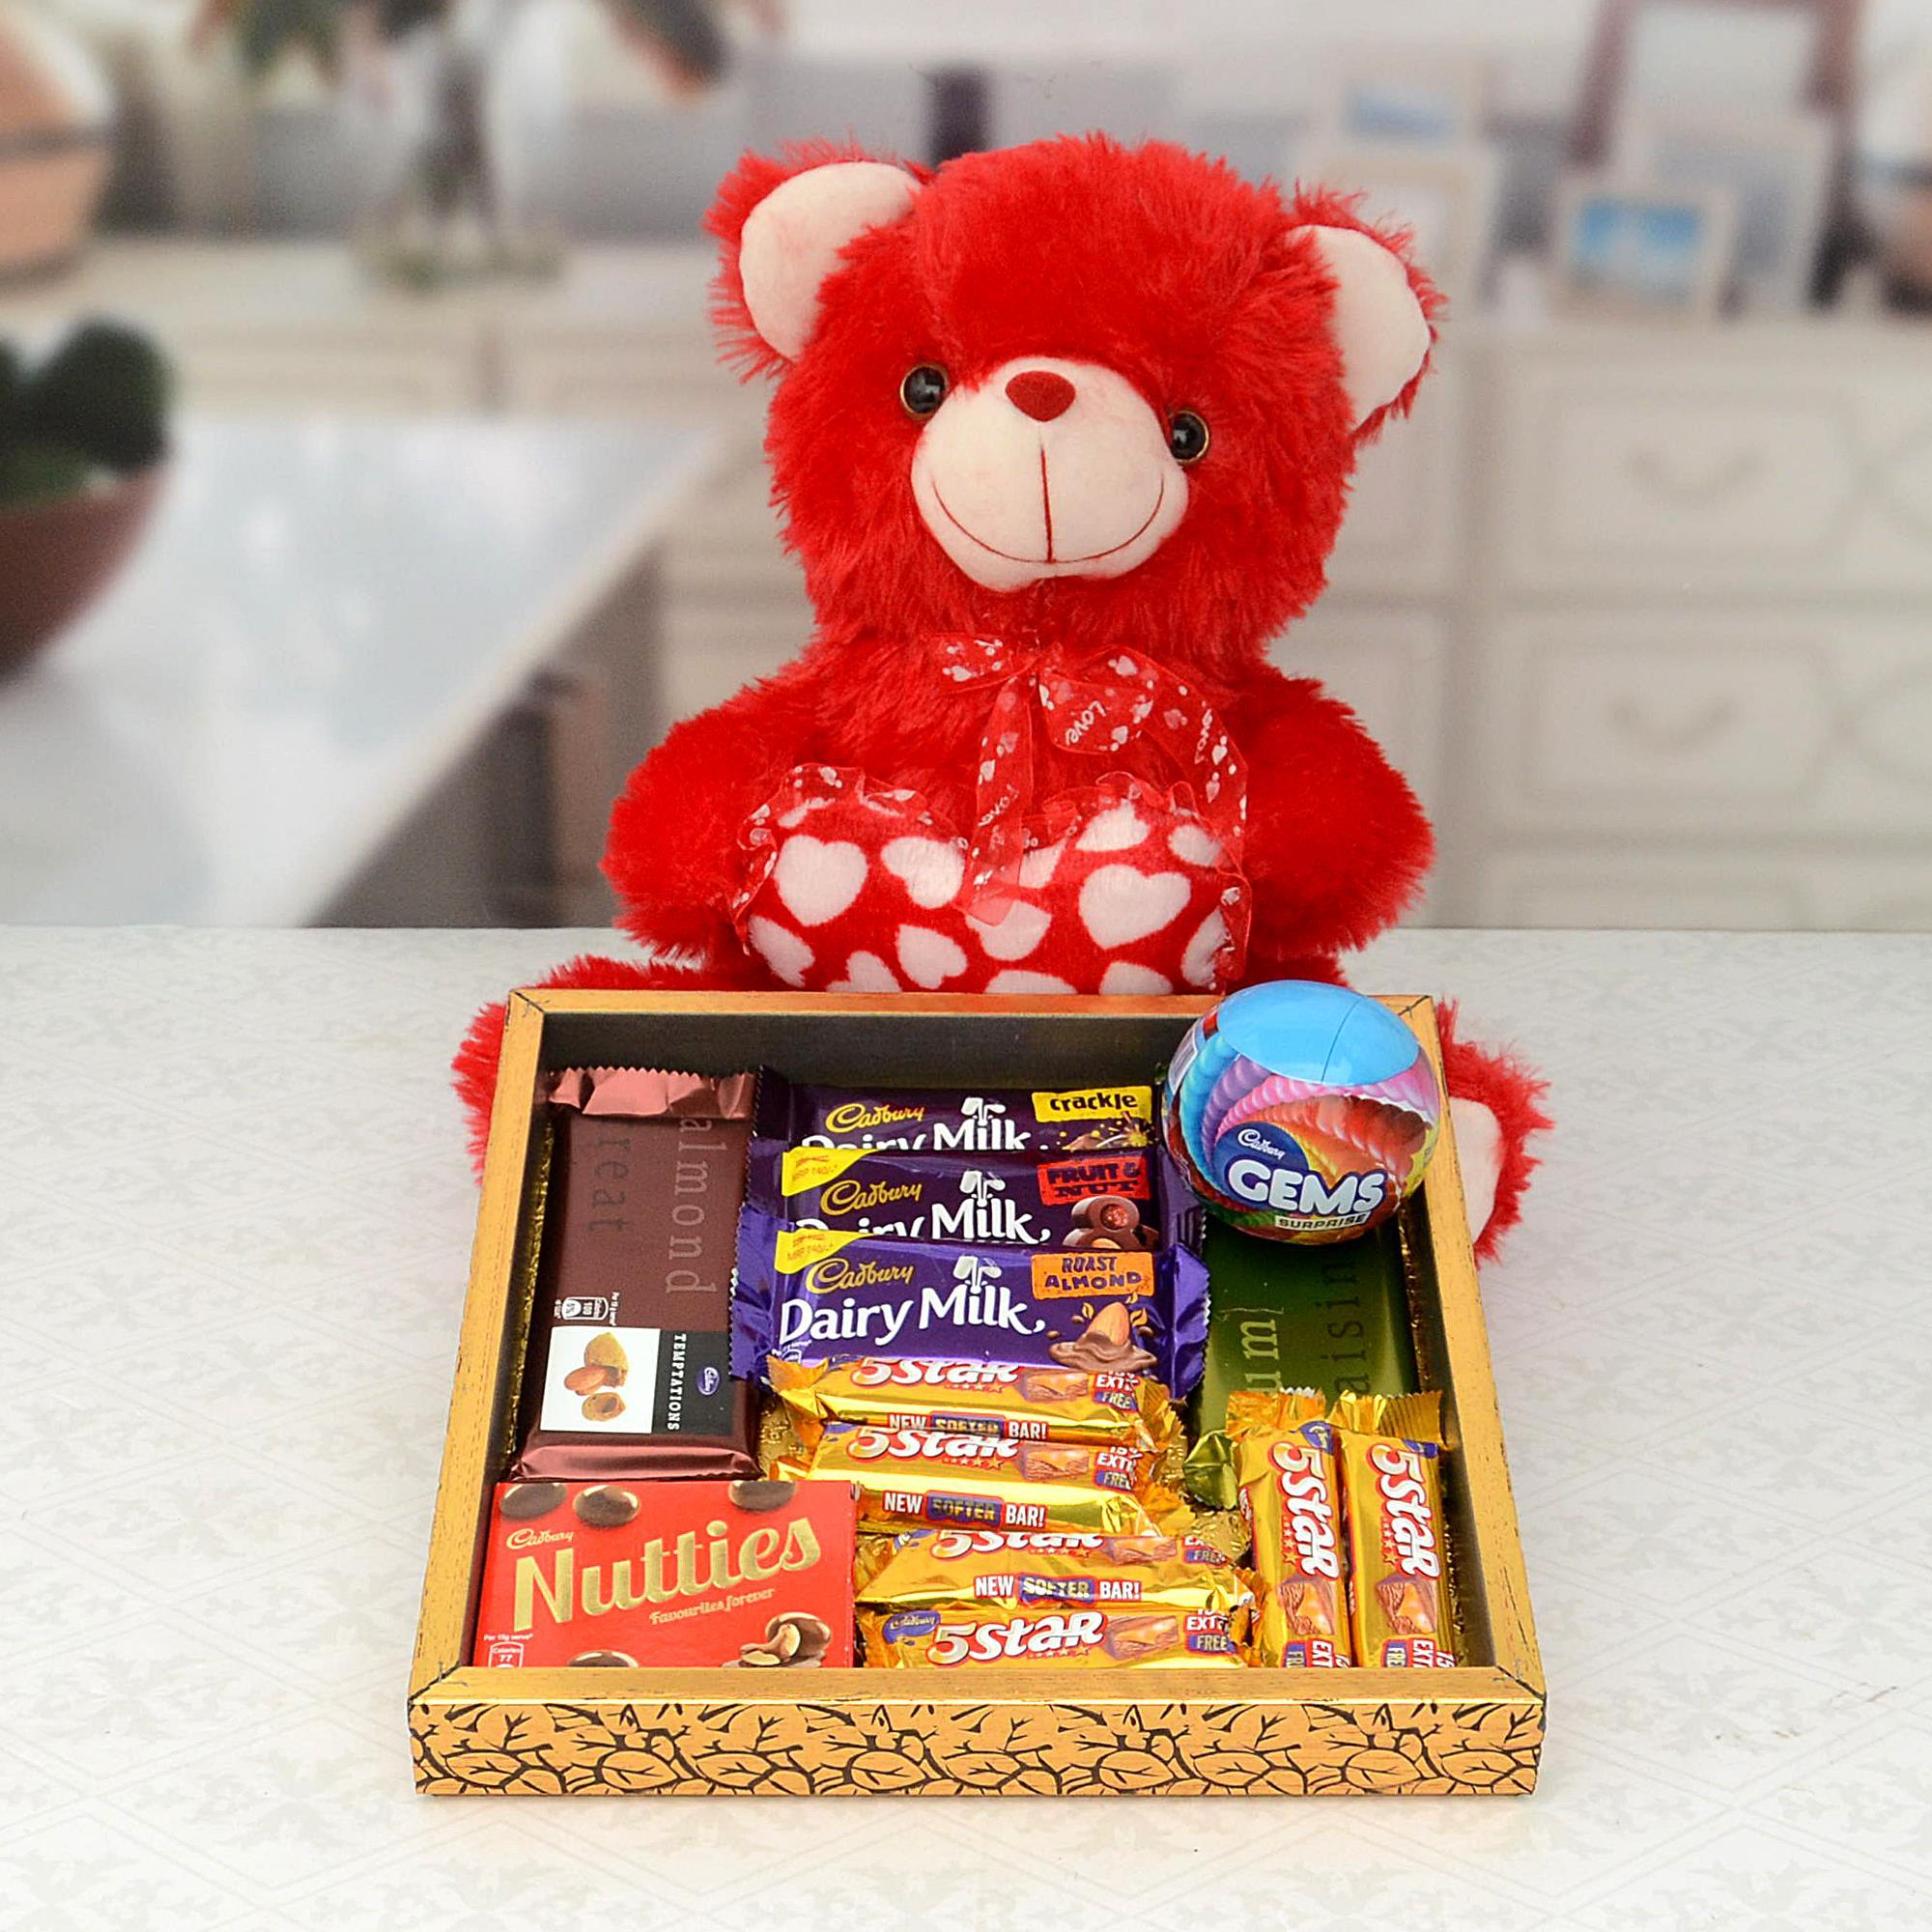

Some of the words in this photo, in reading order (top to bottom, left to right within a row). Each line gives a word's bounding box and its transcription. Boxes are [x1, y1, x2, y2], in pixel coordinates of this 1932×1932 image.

[1050, 1093, 1138, 1111] crackle
[826, 1103, 924, 1133] Cadbury
[1238, 1129, 1286, 1159] Cadbury
[588, 1137, 631, 1233] reat
[1047, 1162, 1120, 1184] FRUIT
[1123, 1161, 1141, 1178] &
[1229, 1159, 1385, 1214] GEMS
[821, 1179, 923, 1216] Cadbury
[1055, 1179, 1139, 1197] NUT
[666, 1115, 727, 1293] almond
[1279, 1213, 1367, 1229] SURPRISE
[806, 1258, 914, 1293] Cadbury
[1063, 1256, 1118, 1273] ROAST
[1045, 1271, 1142, 1291] ALMOND
[779, 1298, 914, 1346] Dairy
[1315, 1258, 1371, 1394] aisin
[1240, 1319, 1282, 1392] um
[668, 1333, 687, 1431] TEMPTATIONS
[890, 1414, 926, 1430] NEW
[1009, 1422, 1047, 1440] BAR!
[884, 1492, 923, 1514] NEW
[931, 1497, 996, 1521] SOFTER
[1006, 1504, 1045, 1527] BAR!
[506, 1528, 574, 1549] Cadbury
[513, 1516, 821, 1633] Nutties
[975, 1576, 1014, 1599] NEW
[1022, 1577, 1091, 1599] SOFTER
[1099, 1581, 1141, 1600] BAR!
[649, 1600, 724, 1625] Favourites
[724, 1588, 776, 1612] forever
[1198, 1634, 1228, 1651] FREE
[1412, 1639, 1435, 1668] EXT
[1286, 1650, 1305, 1668] FR
